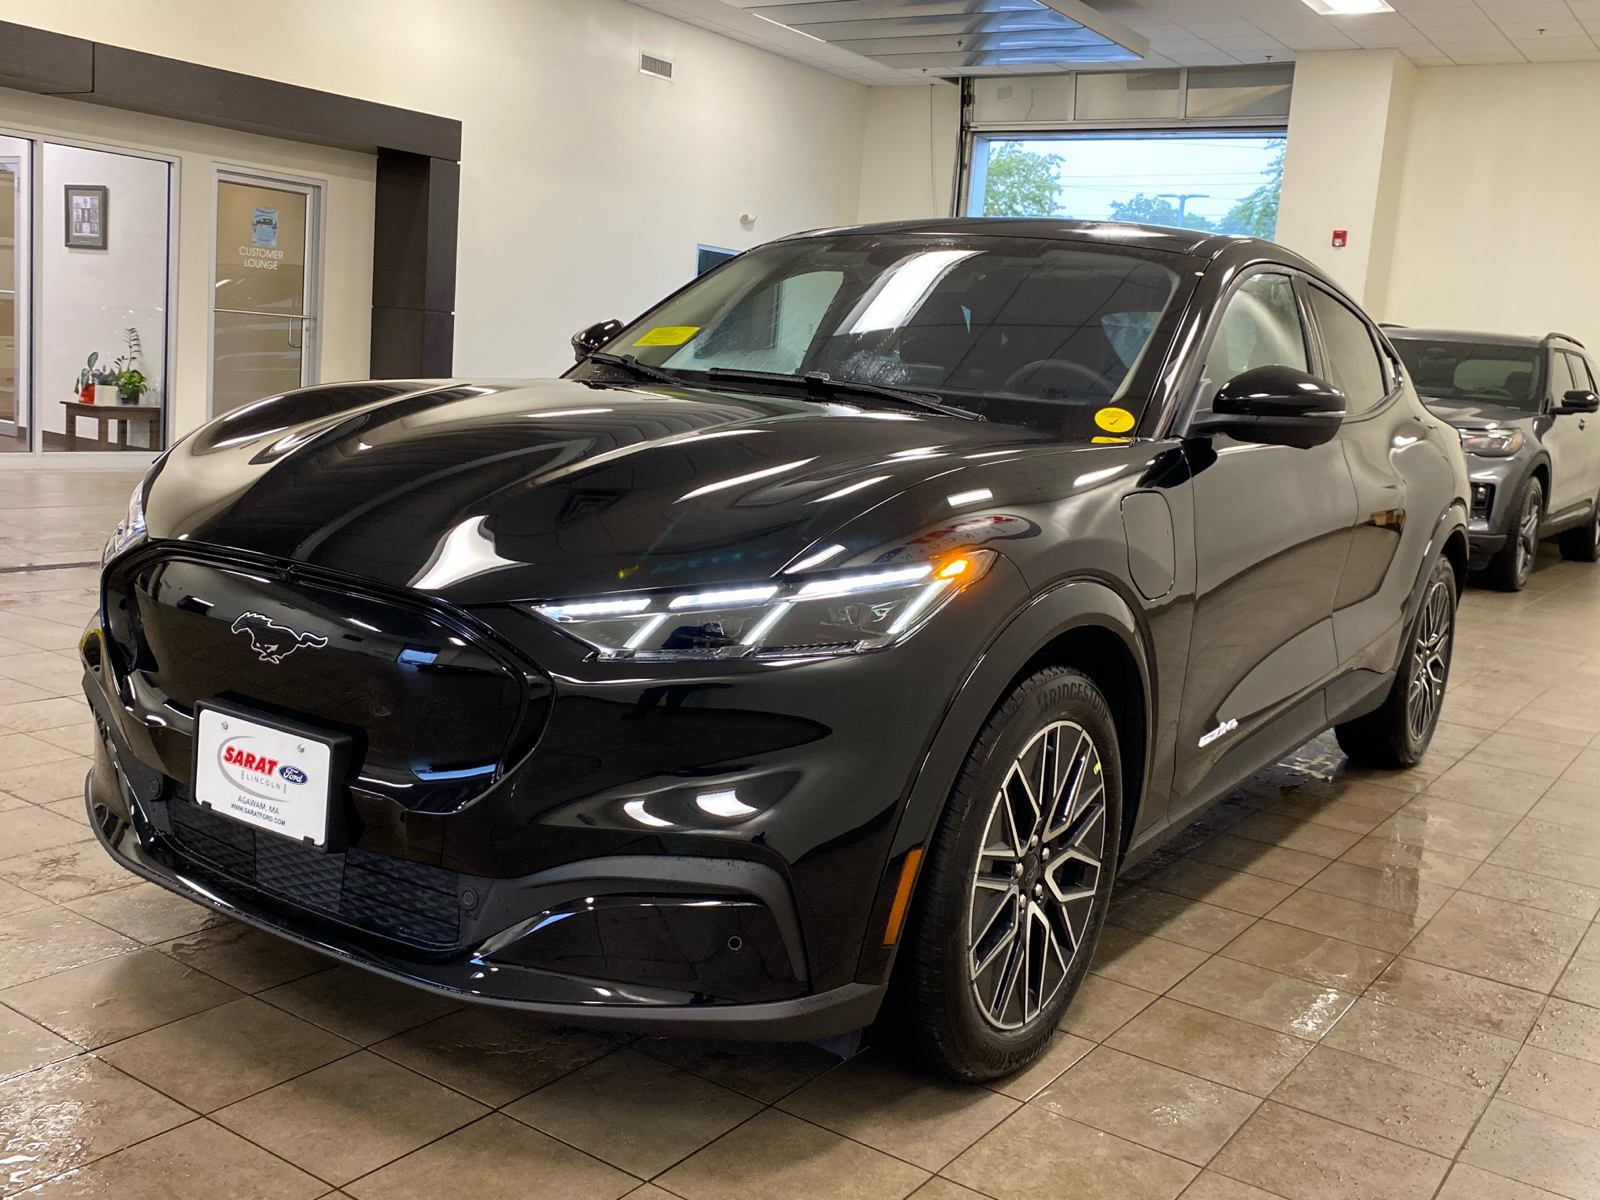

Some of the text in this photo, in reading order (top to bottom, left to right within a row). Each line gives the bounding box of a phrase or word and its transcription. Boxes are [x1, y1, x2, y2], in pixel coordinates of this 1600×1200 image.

[239, 246, 284, 260] CUSTOMER
[244, 258, 278, 270] LOUNGE
[222, 745, 279, 776] SARAT
[246, 771, 281, 790] LINCOLN
[281, 766, 304, 783] Ford
[230, 803, 286, 826] WWW.SARATFORD.COM
[238, 795, 280, 816] AGAWAM, MA
